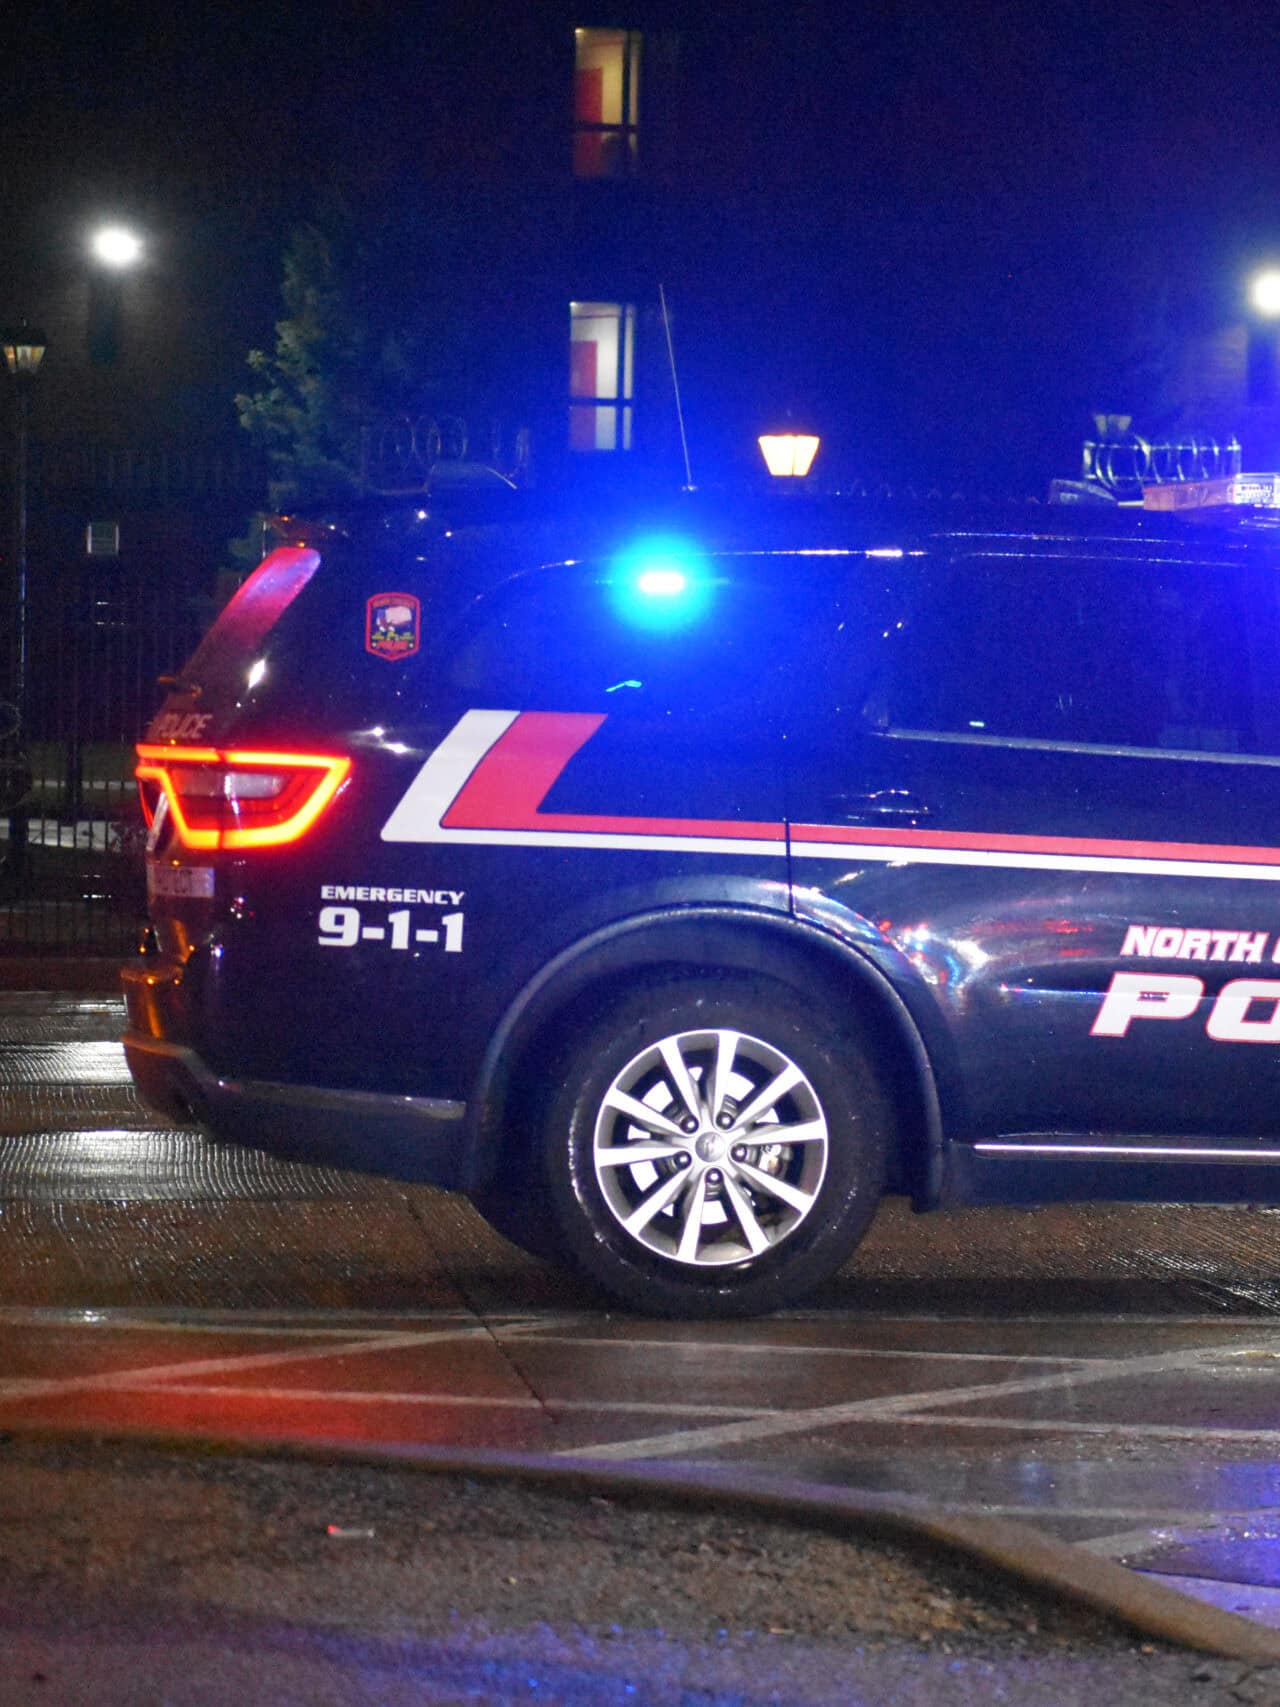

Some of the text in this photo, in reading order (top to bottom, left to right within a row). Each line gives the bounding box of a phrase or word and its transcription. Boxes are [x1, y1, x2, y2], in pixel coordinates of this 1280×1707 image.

[320, 885, 465, 905] EMERGENCY
[318, 906, 465, 953] 9-1-1
[1119, 924, 1270, 964] NORTH
